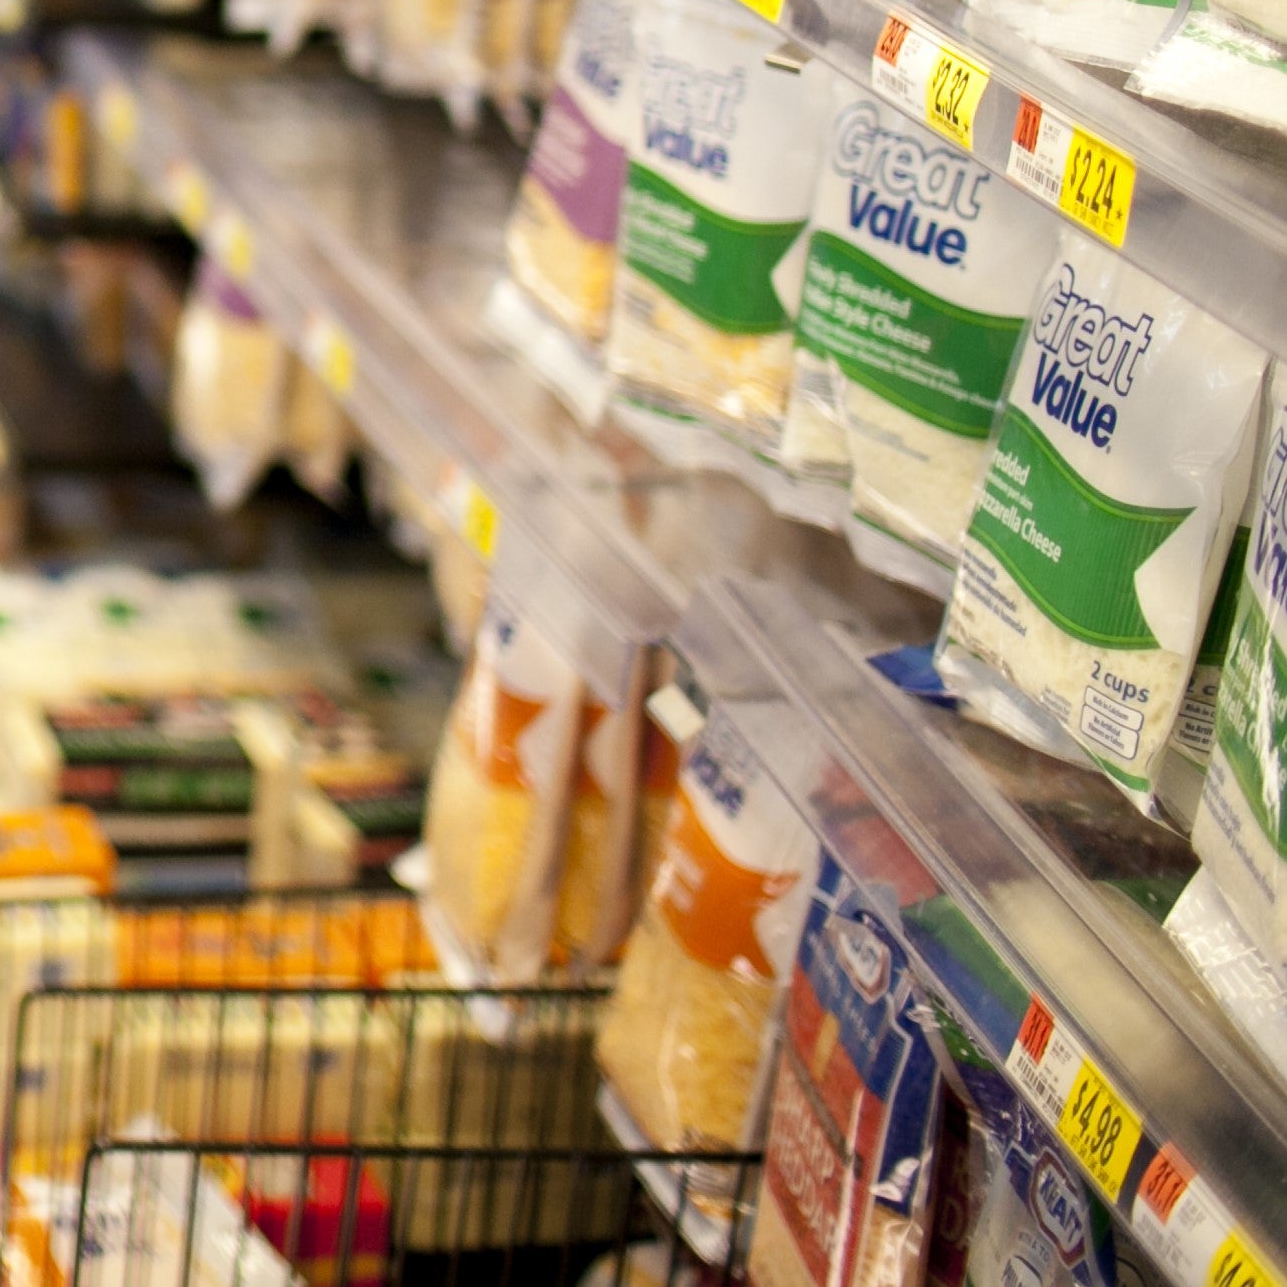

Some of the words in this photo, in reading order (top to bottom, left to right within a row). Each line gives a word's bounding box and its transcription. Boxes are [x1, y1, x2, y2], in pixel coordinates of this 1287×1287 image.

[933, 58, 970, 126] $2.32
[833, 100, 991, 221] Great
[1070, 146, 1118, 219] $2.24
[849, 182, 967, 265] Value
[1034, 262, 1154, 397] Great
[1032, 352, 1118, 448] Value
[993, 447, 1031, 487] redded
[1021, 517, 1062, 563] Cheese
[1091, 660, 1101, 681] 2
[1103, 671, 1150, 703] cups
[1072, 1078, 1123, 1167] $4.98
